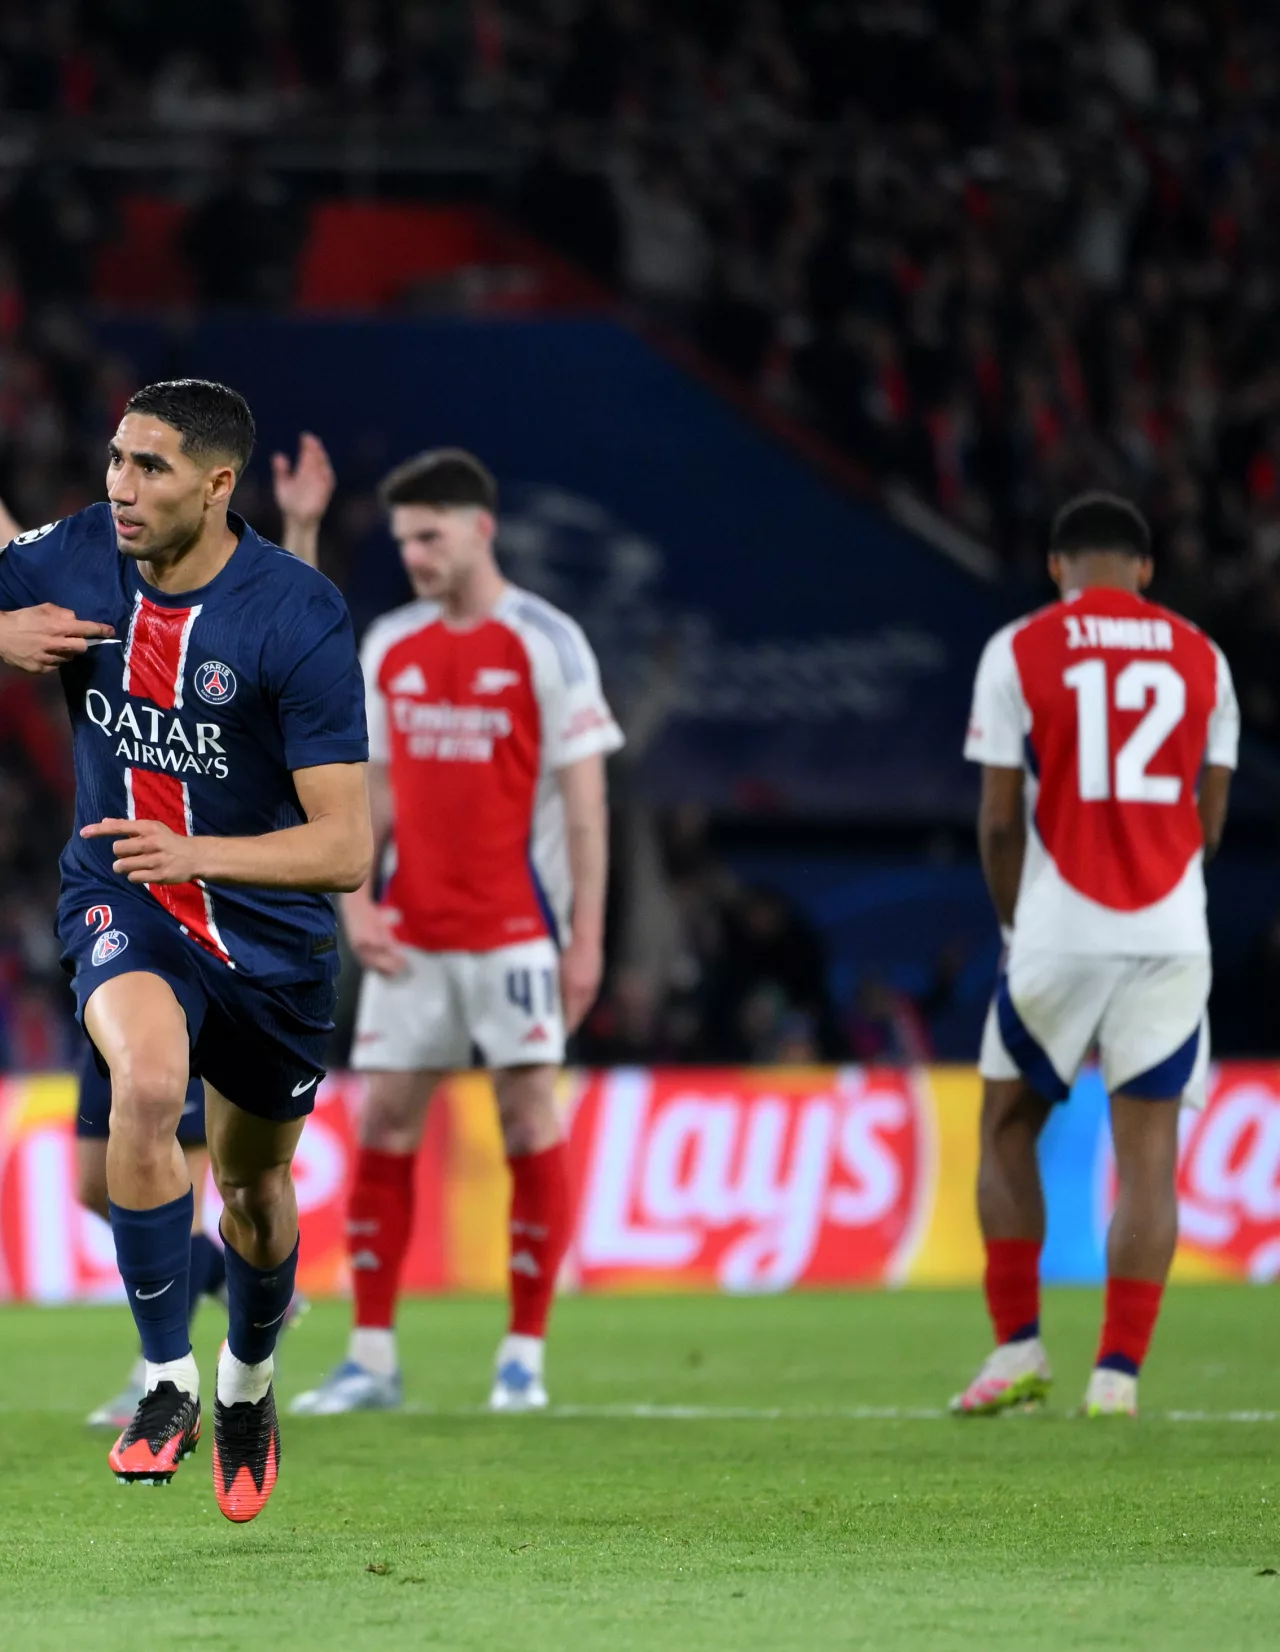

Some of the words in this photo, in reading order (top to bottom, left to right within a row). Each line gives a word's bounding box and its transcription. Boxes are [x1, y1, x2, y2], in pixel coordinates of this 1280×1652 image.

[203, 663, 230, 677] PARIS
[86, 688, 227, 755] QATAR
[1062, 657, 1187, 804] 12
[115, 737, 230, 779] AIRWAYS
[505, 966, 558, 1016] 41
[577, 1063, 908, 1297] Lay's
